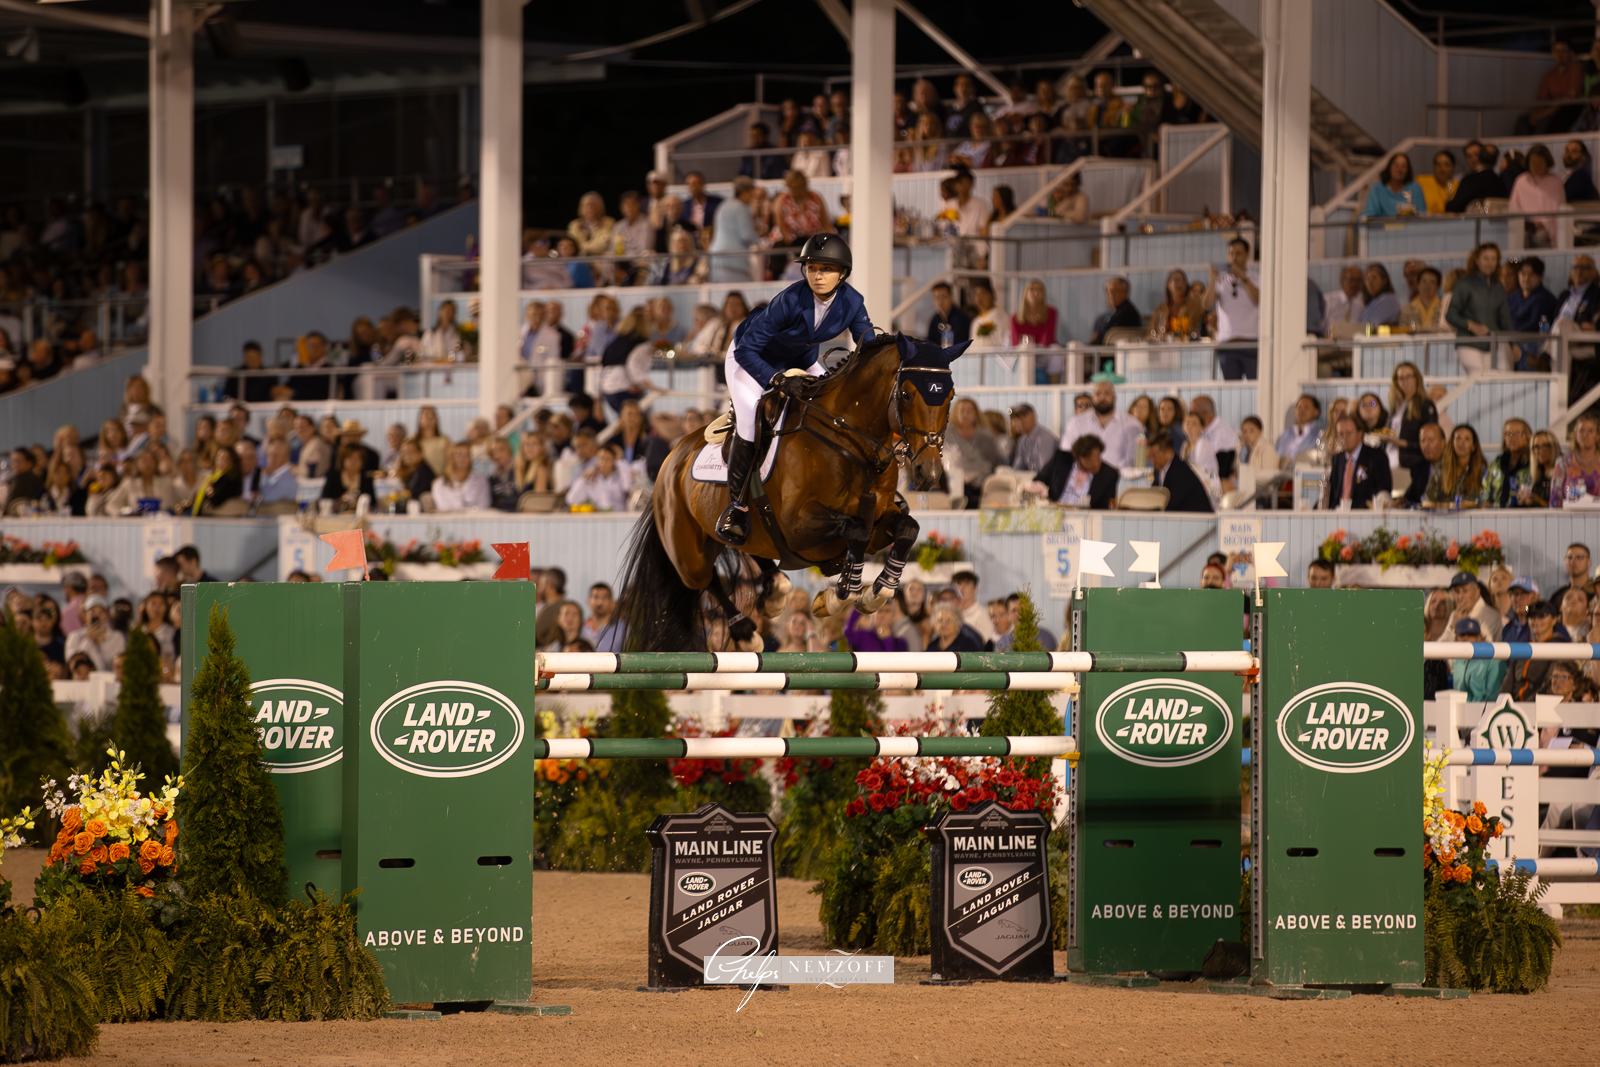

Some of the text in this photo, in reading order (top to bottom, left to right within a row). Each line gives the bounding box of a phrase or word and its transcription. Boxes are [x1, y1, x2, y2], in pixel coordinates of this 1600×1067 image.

[1231, 524, 1252, 533] MAIN
[1058, 548, 1070, 575] 5
[250, 700, 312, 723] AND
[403, 703, 475, 726] LAND
[1124, 699, 1188, 720] LAND
[1306, 702, 1370, 725] LAND
[409, 729, 496, 753] ROVER
[1129, 723, 1207, 745] ROVER
[1311, 728, 1389, 750] ROVER
[675, 840, 763, 856] MAIN LINE
[954, 835, 1037, 851] MAIN LINE
[964, 871, 982, 879] LAND
[682, 877, 755, 922] LAND ROVER
[962, 871, 1030, 916] LAND ROVER
[697, 899, 744, 930] JAGUAR
[977, 893, 1020, 924] JAGUAR
[1091, 904, 1234, 919] ABOVE & BEYOND
[1275, 914, 1417, 930] ABOVE & BEYOND
[364, 926, 524, 947] ABOVE & BEYOND
